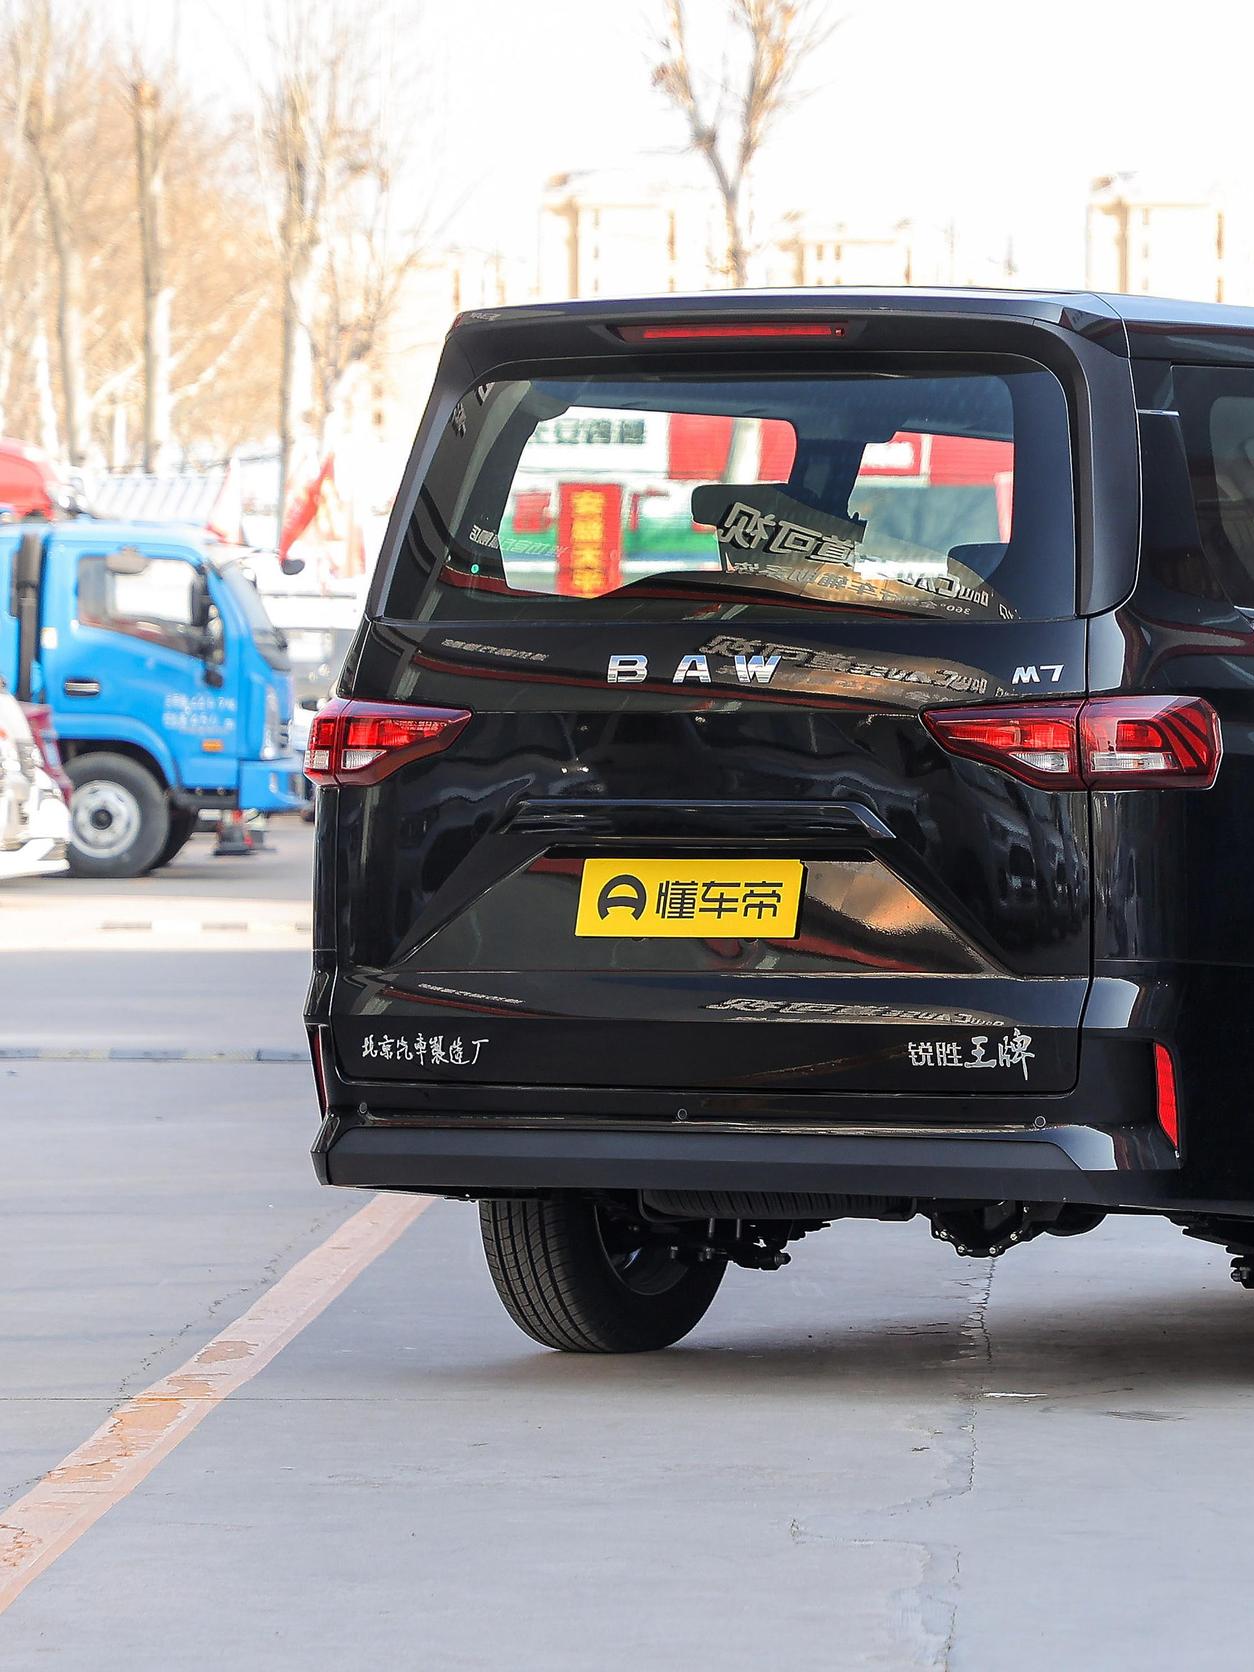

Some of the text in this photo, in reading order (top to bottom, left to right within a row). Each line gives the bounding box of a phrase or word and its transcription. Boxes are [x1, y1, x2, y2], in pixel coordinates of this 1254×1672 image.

[607, 654, 782, 684] BAW
[1011, 664, 1064, 685] M7
[655, 880, 784, 920] 懂车帝
[907, 1027, 1036, 1081] 锐胜王牌
